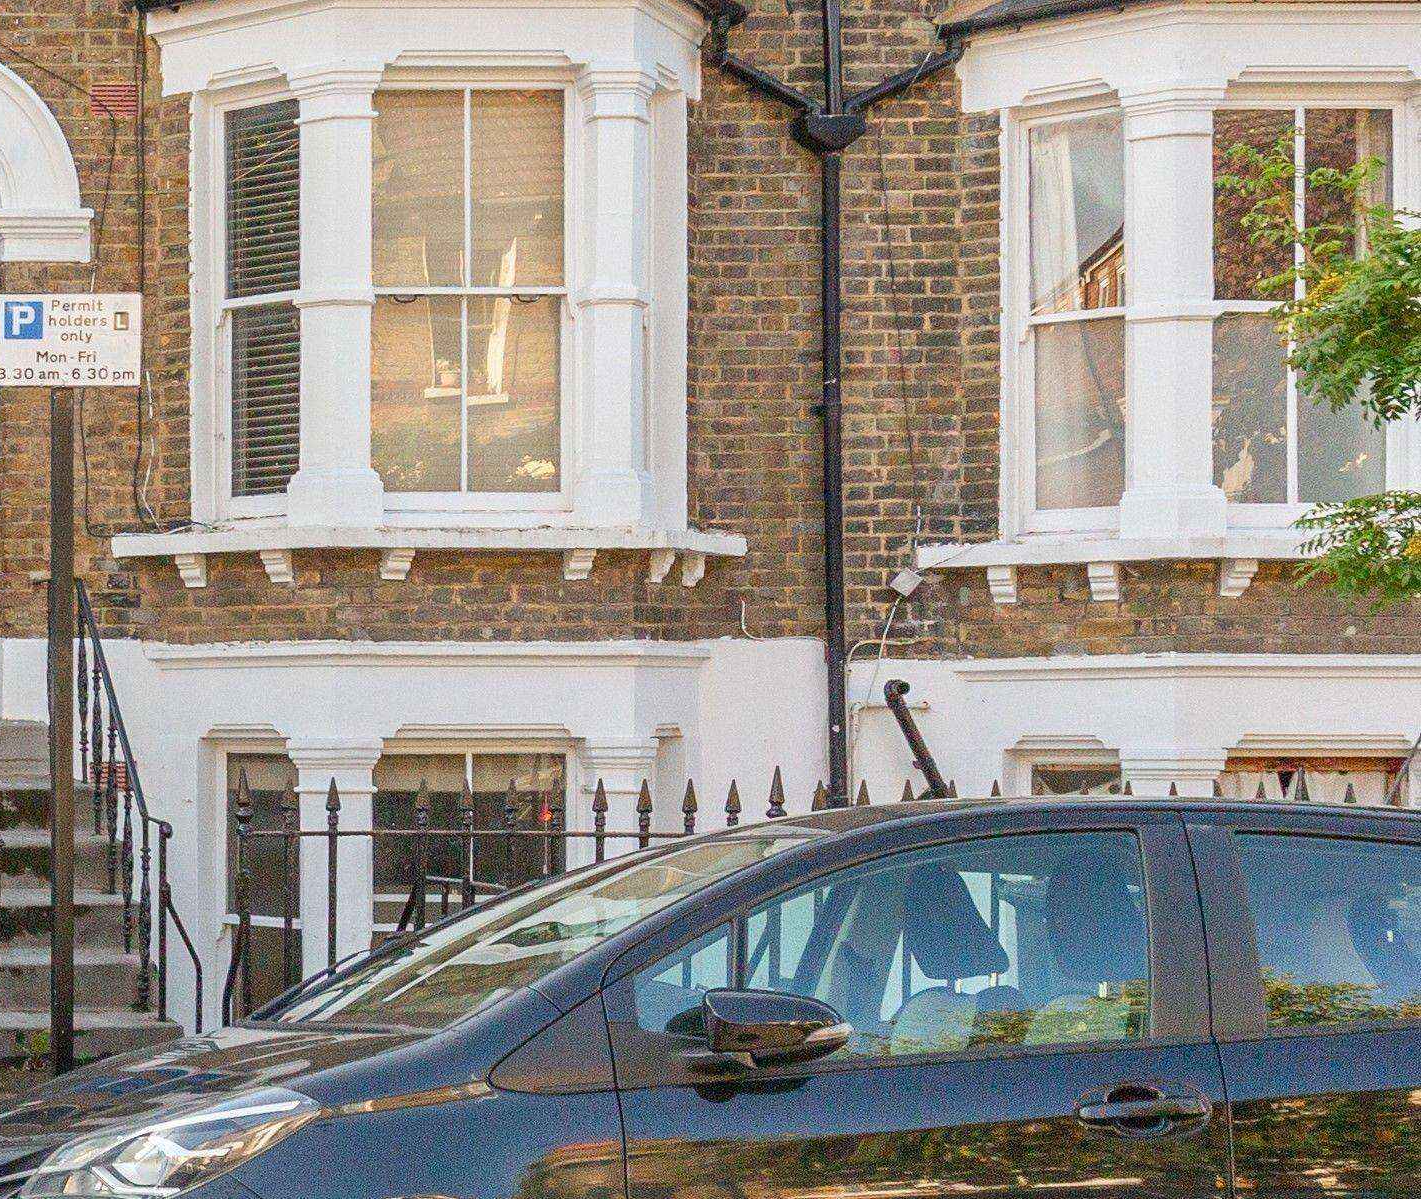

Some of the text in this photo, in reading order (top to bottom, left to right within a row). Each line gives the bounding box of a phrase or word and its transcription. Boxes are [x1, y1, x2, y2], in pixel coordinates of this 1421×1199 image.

[50, 299, 104, 312] Permit
[11, 305, 37, 336] P
[47, 314, 108, 327] holders
[116, 313, 127, 329] L
[60, 330, 93, 344] only
[35, 350, 67, 363] Mon
[77, 350, 97, 363] Fri
[37, 371, 60, 380] am
[71, 367, 109, 380] 6.30
[112, 371, 136, 382] pm
